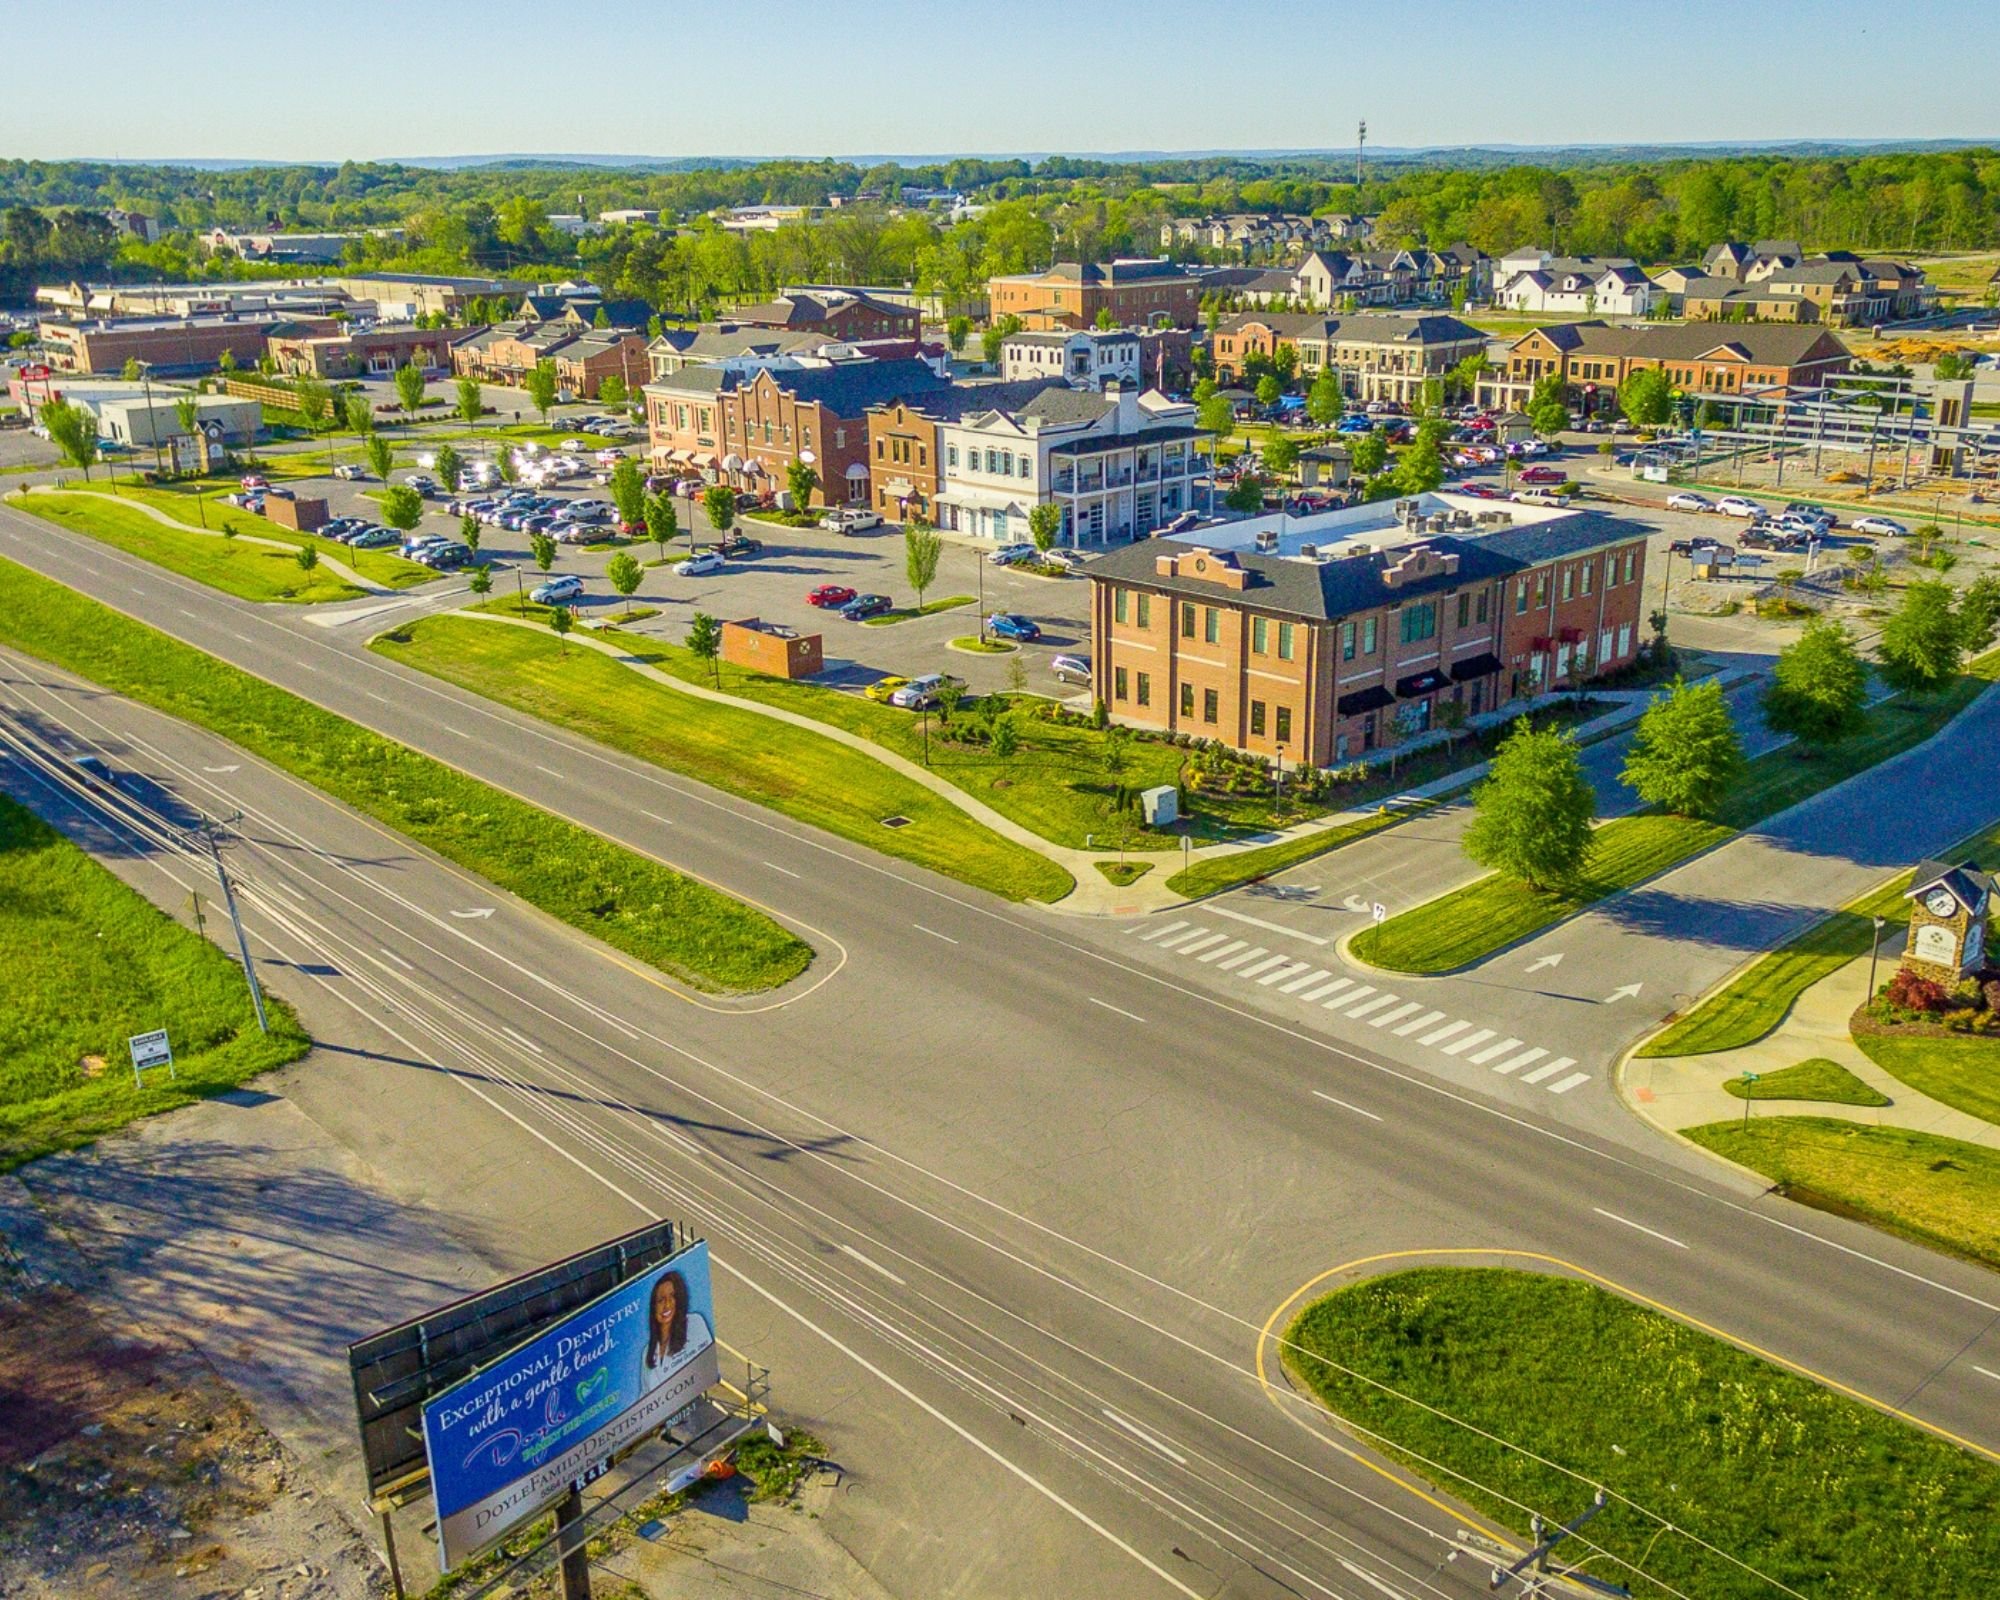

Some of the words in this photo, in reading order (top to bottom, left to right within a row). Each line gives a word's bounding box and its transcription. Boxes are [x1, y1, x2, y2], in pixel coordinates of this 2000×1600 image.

[439, 1353, 553, 1432] EXCEPTIONAL
[557, 1298, 641, 1359] DENTISTRY
[468, 1396, 507, 1437] with
[511, 1398, 522, 1411] a
[524, 1359, 572, 1409] gentle
[576, 1473, 588, 1491] R
[598, 1457, 609, 1475] R
